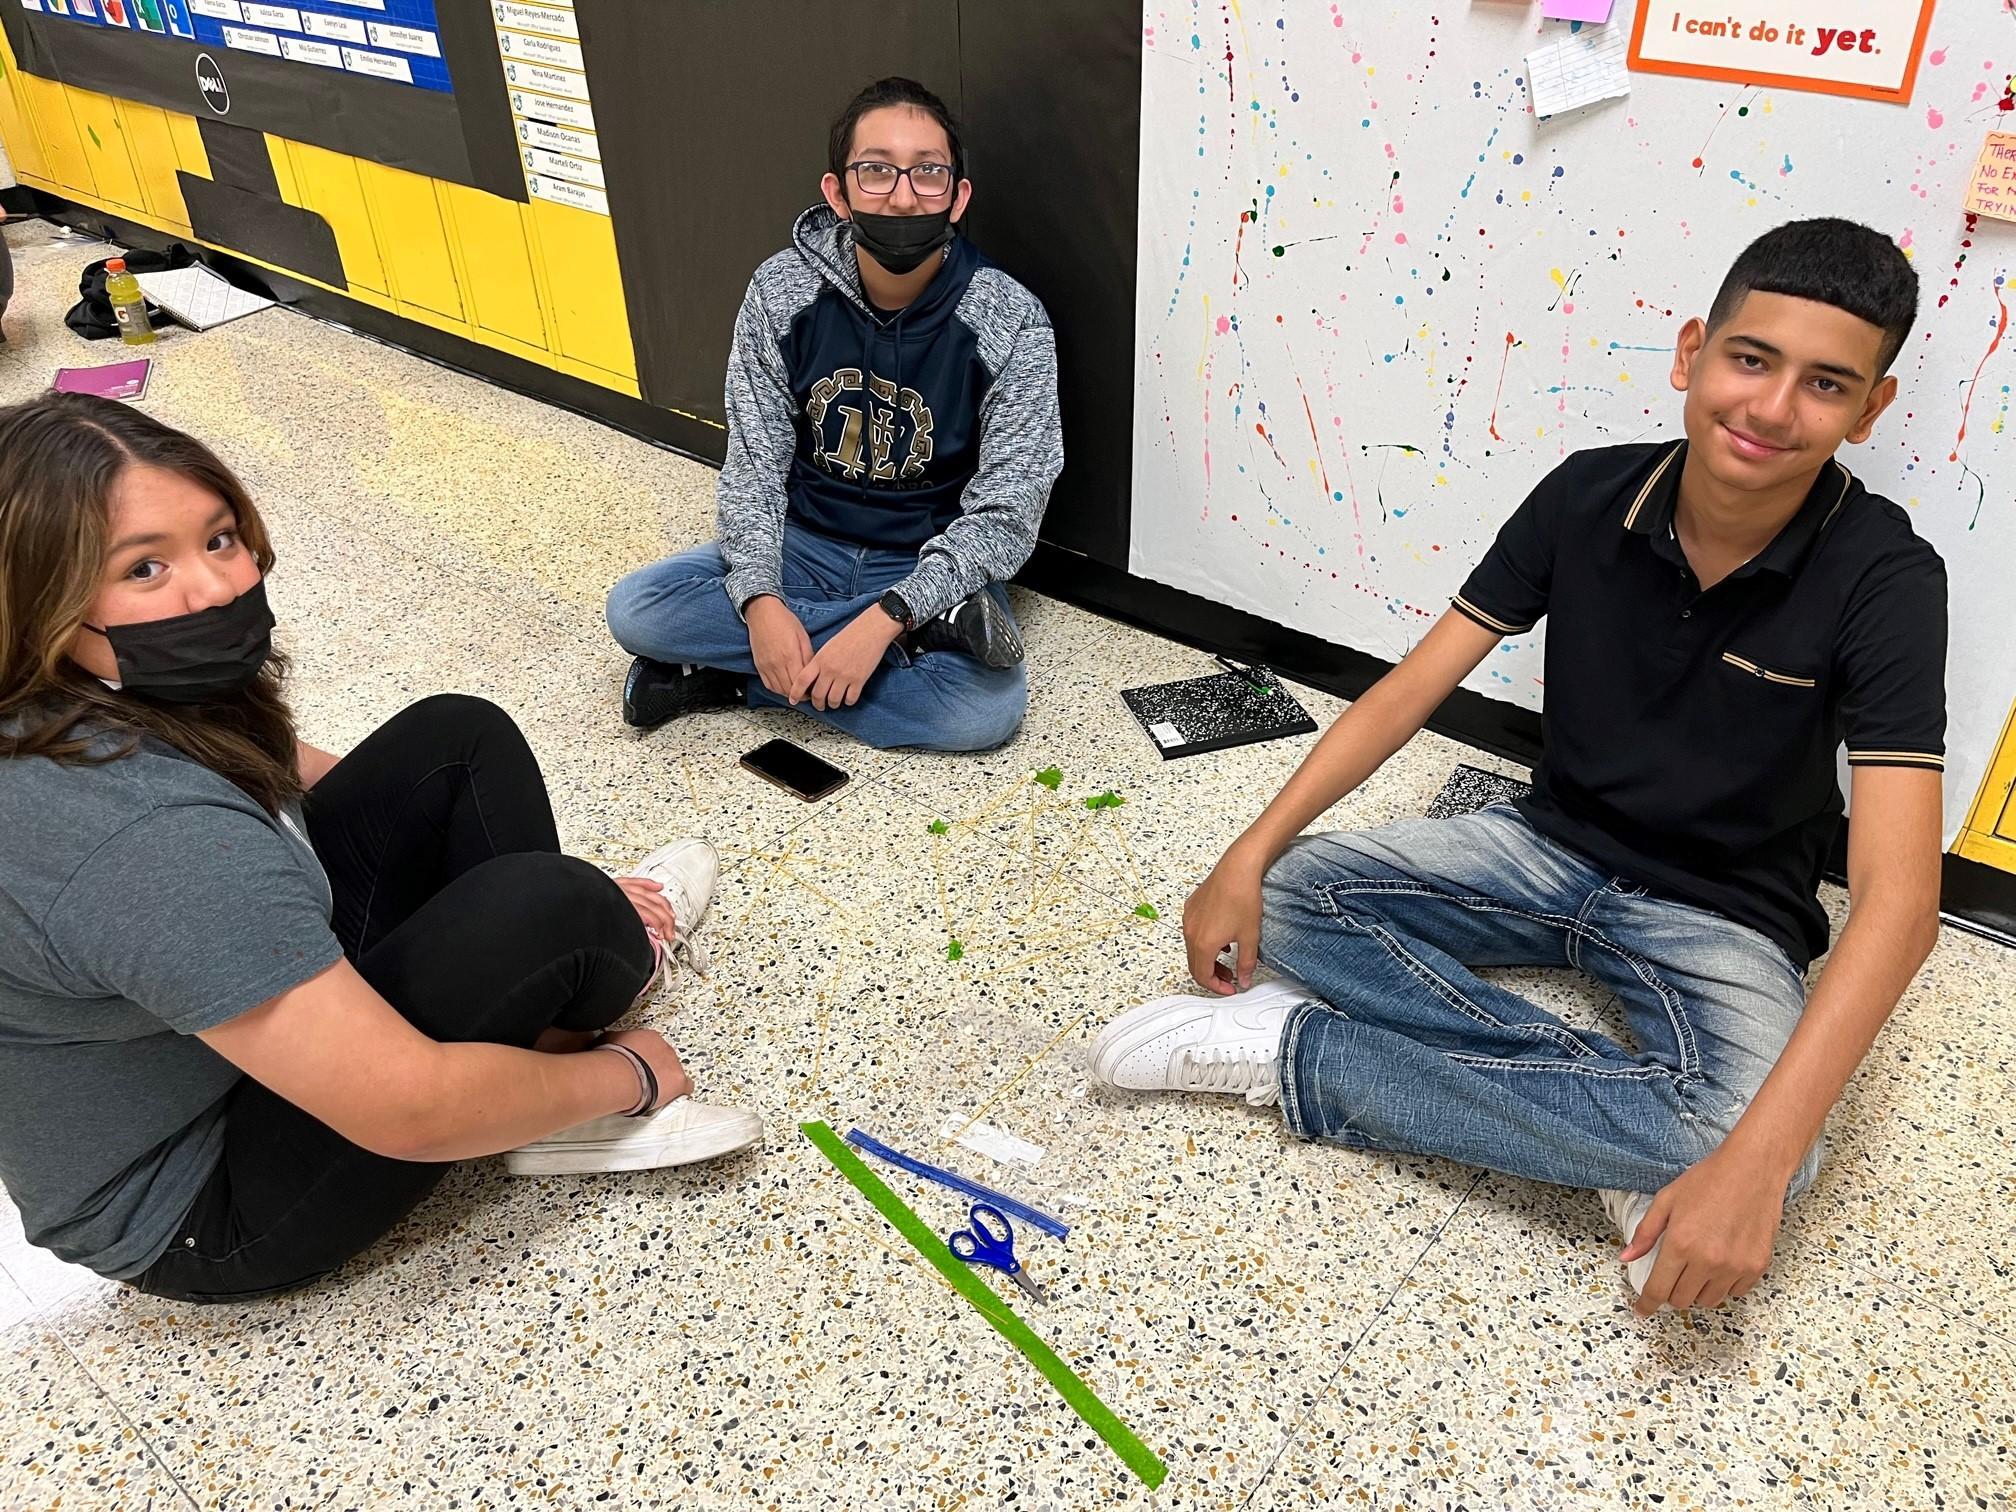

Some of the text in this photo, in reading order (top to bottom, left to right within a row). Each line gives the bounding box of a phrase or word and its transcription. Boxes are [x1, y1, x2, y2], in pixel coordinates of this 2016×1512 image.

[506, 6, 565, 22] Miguel Reyes-Mercado
[389, 30, 408, 40] Jennifer
[1672, 12, 1881, 56] I can't do it yet.
[523, 38, 561, 52] Carla Rodriguez
[531, 69, 566, 83] Nina Martinez
[199, 76, 226, 93] DELL
[545, 100, 574, 113] Hernandez
[536, 127, 560, 139] Madison
[569, 160, 583, 172] Ortiz
